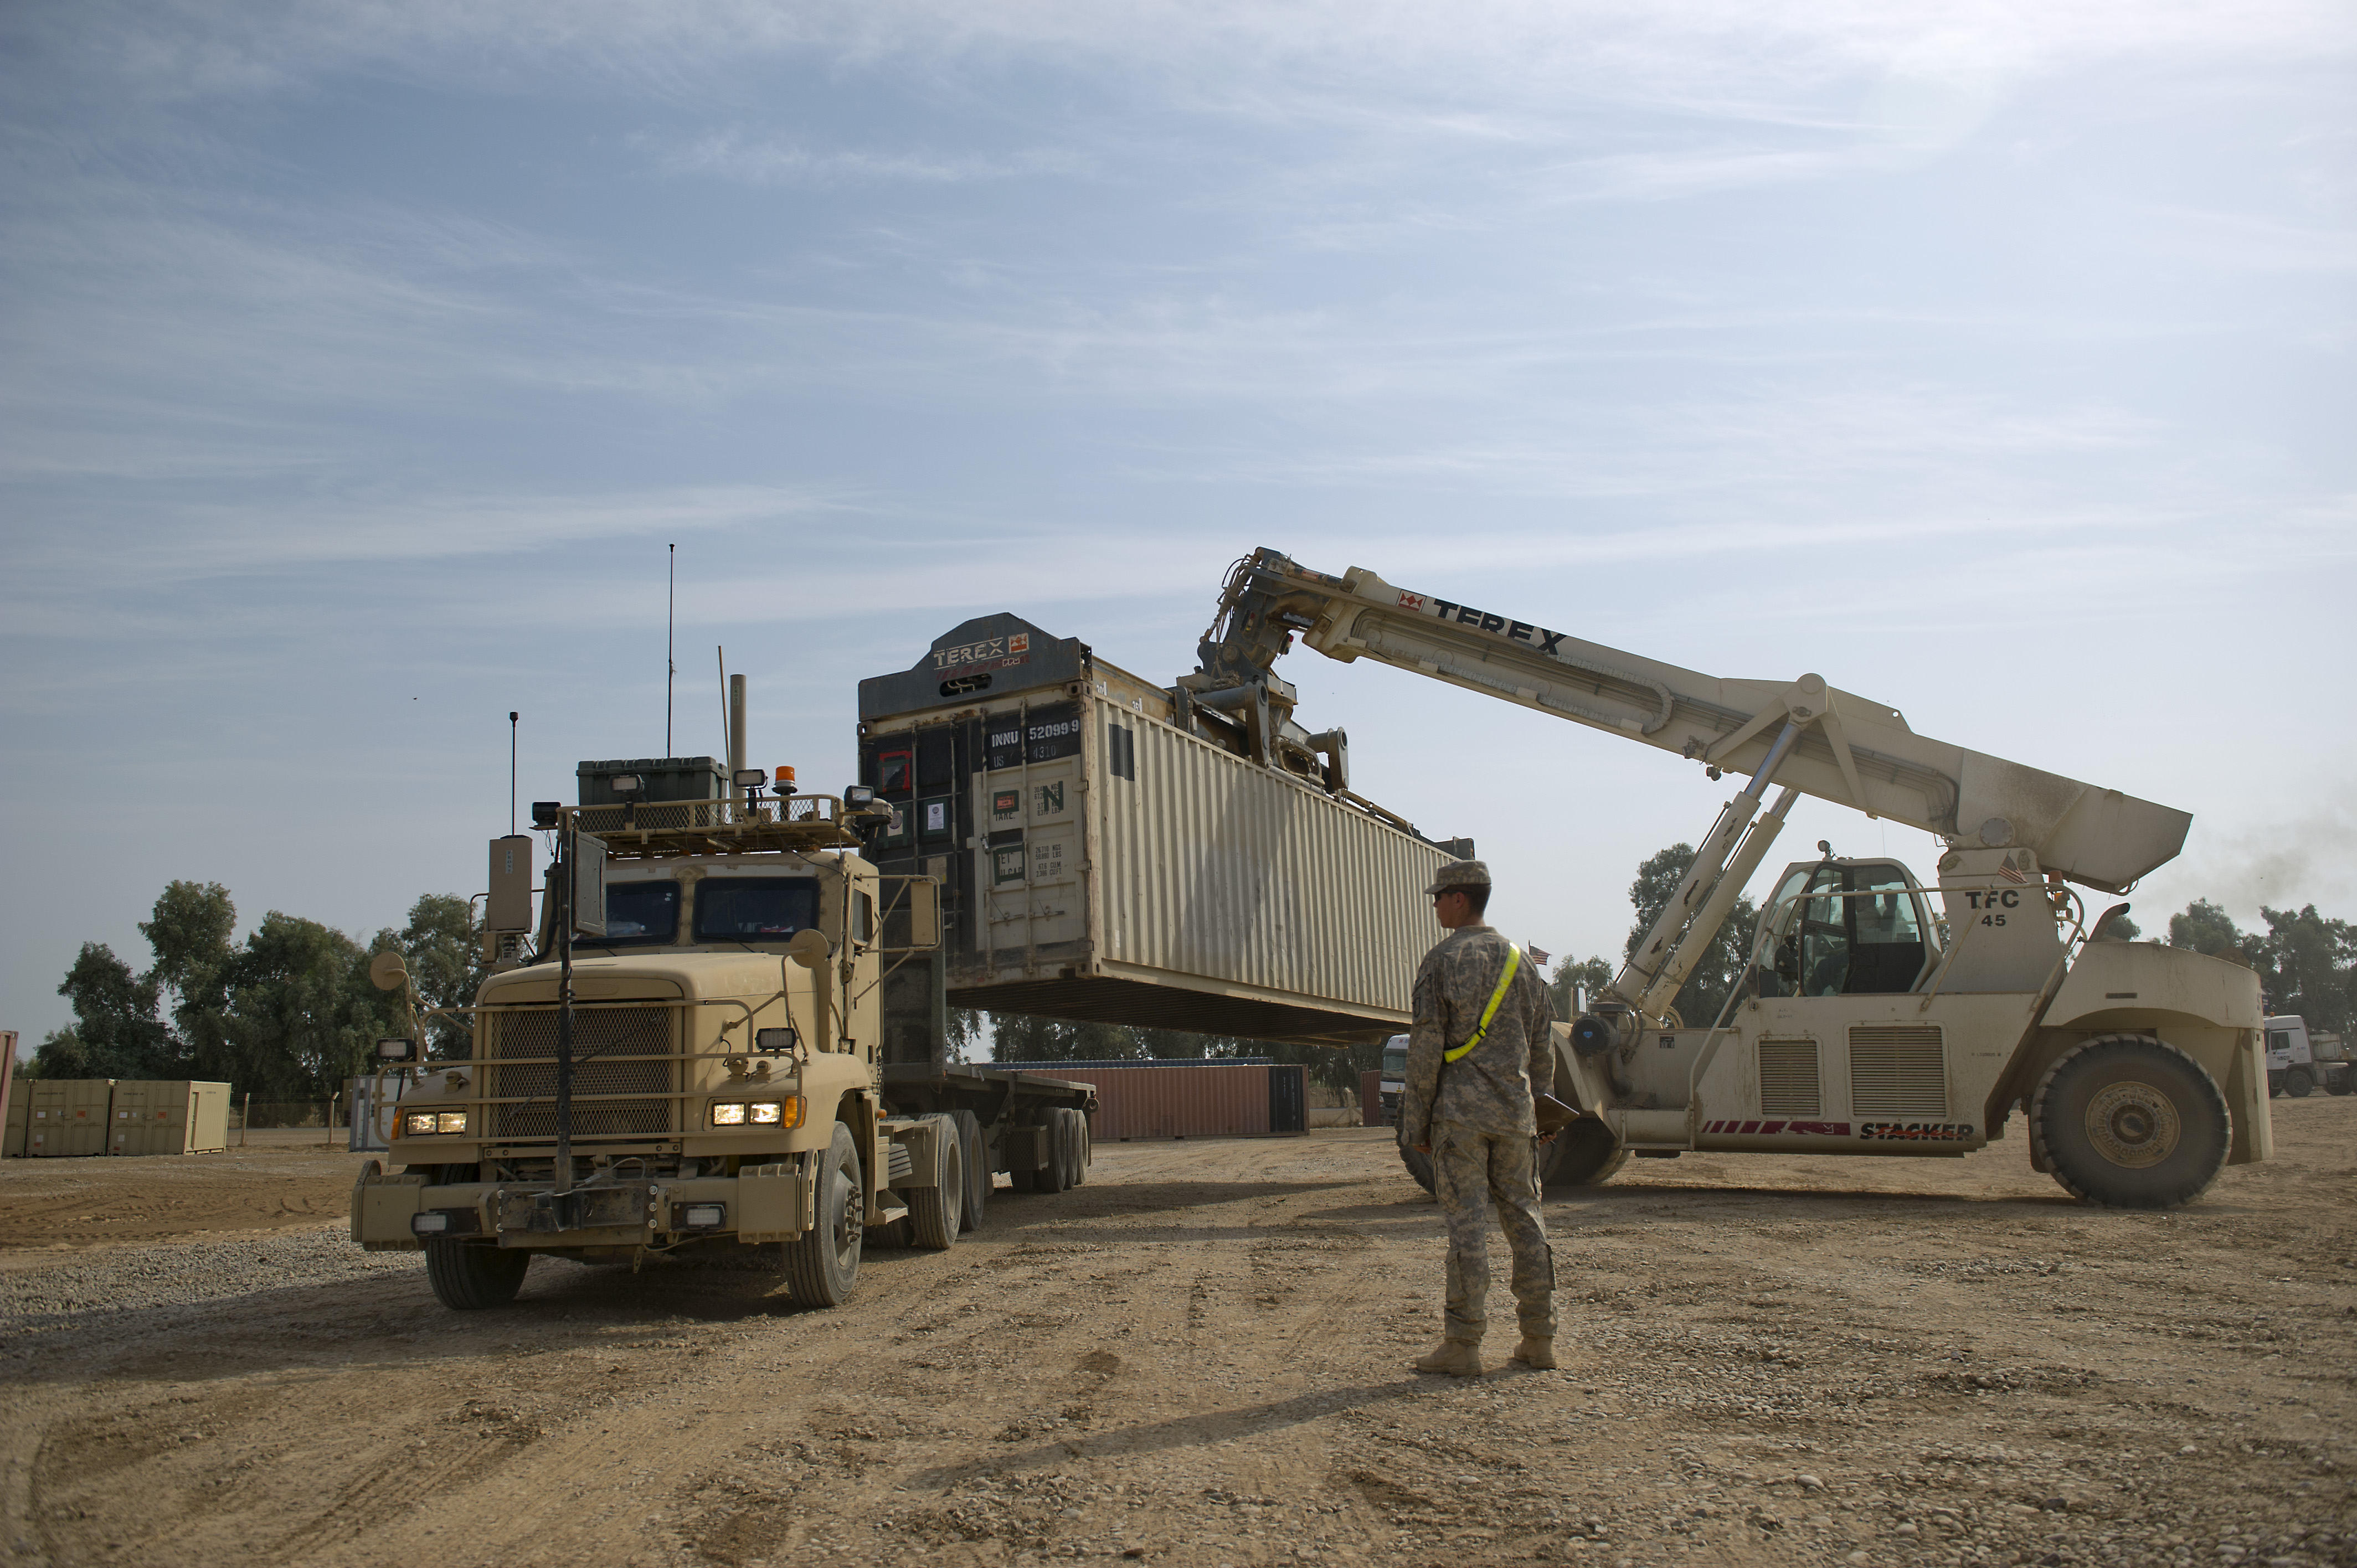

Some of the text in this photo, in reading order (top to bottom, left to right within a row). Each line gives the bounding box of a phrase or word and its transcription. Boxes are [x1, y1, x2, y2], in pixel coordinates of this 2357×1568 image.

[1433, 599, 1567, 656] TEREX
[934, 640, 1003, 666] TEREX
[992, 730, 1018, 747] INNU
[994, 745, 1057, 767] US 4310
[1965, 889, 2019, 909] TFC
[1981, 914, 2006, 927] 45
[1859, 1122, 1974, 1141] STACKER
